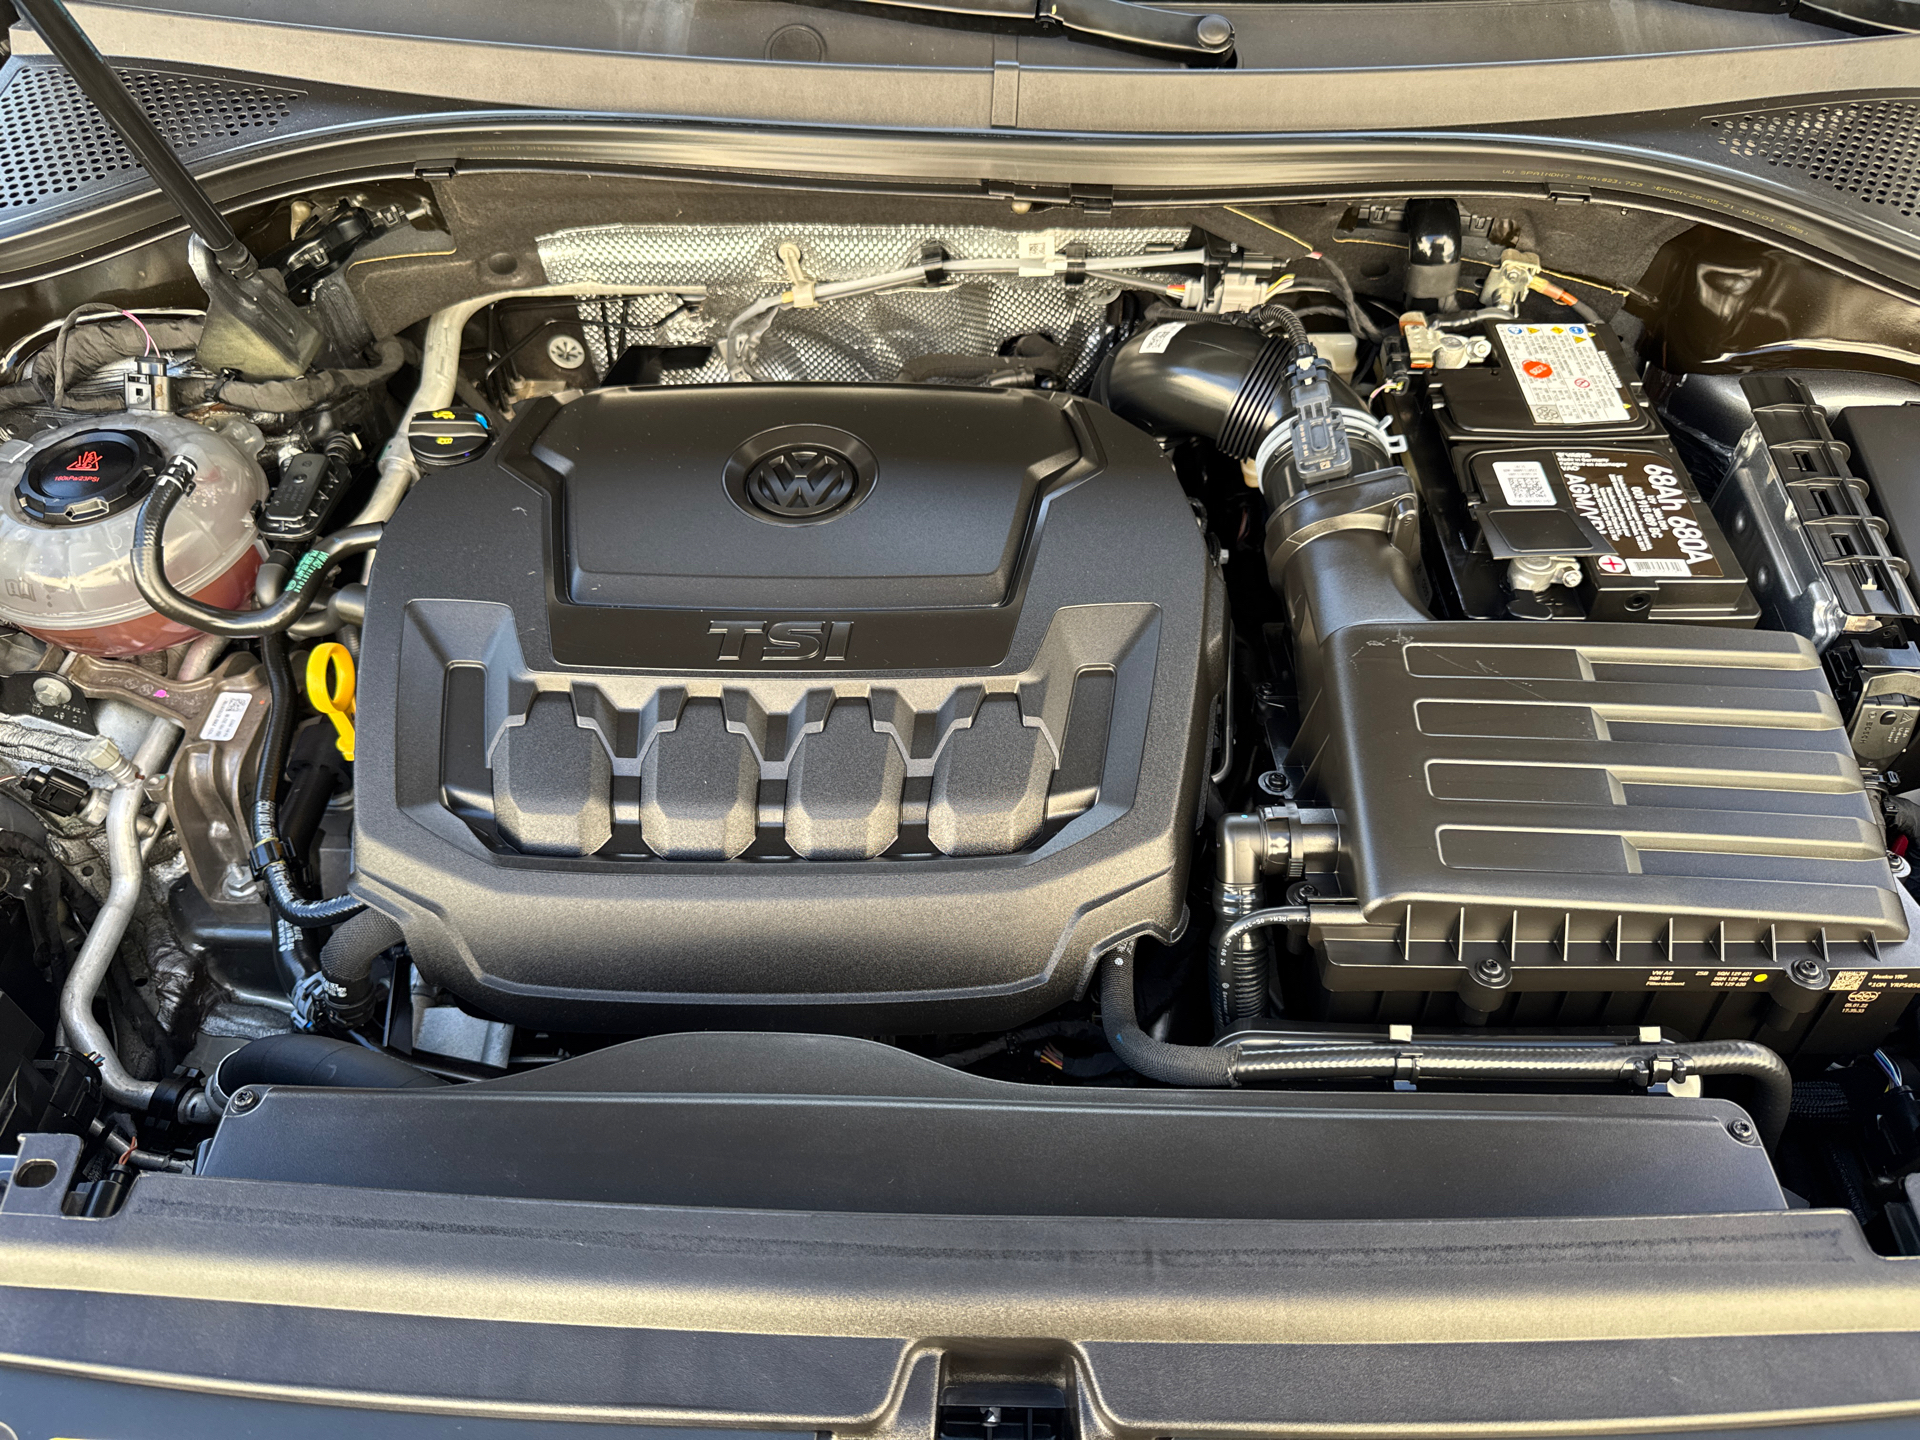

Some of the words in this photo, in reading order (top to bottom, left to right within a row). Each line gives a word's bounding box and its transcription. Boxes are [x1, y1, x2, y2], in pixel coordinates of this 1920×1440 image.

[1636, 500, 1652, 513] 915
[1648, 527, 1663, 538] BC
[1643, 464, 1687, 511] 68Ah
[1667, 516, 1713, 565] 680A
[707, 620, 855, 662] TSI
